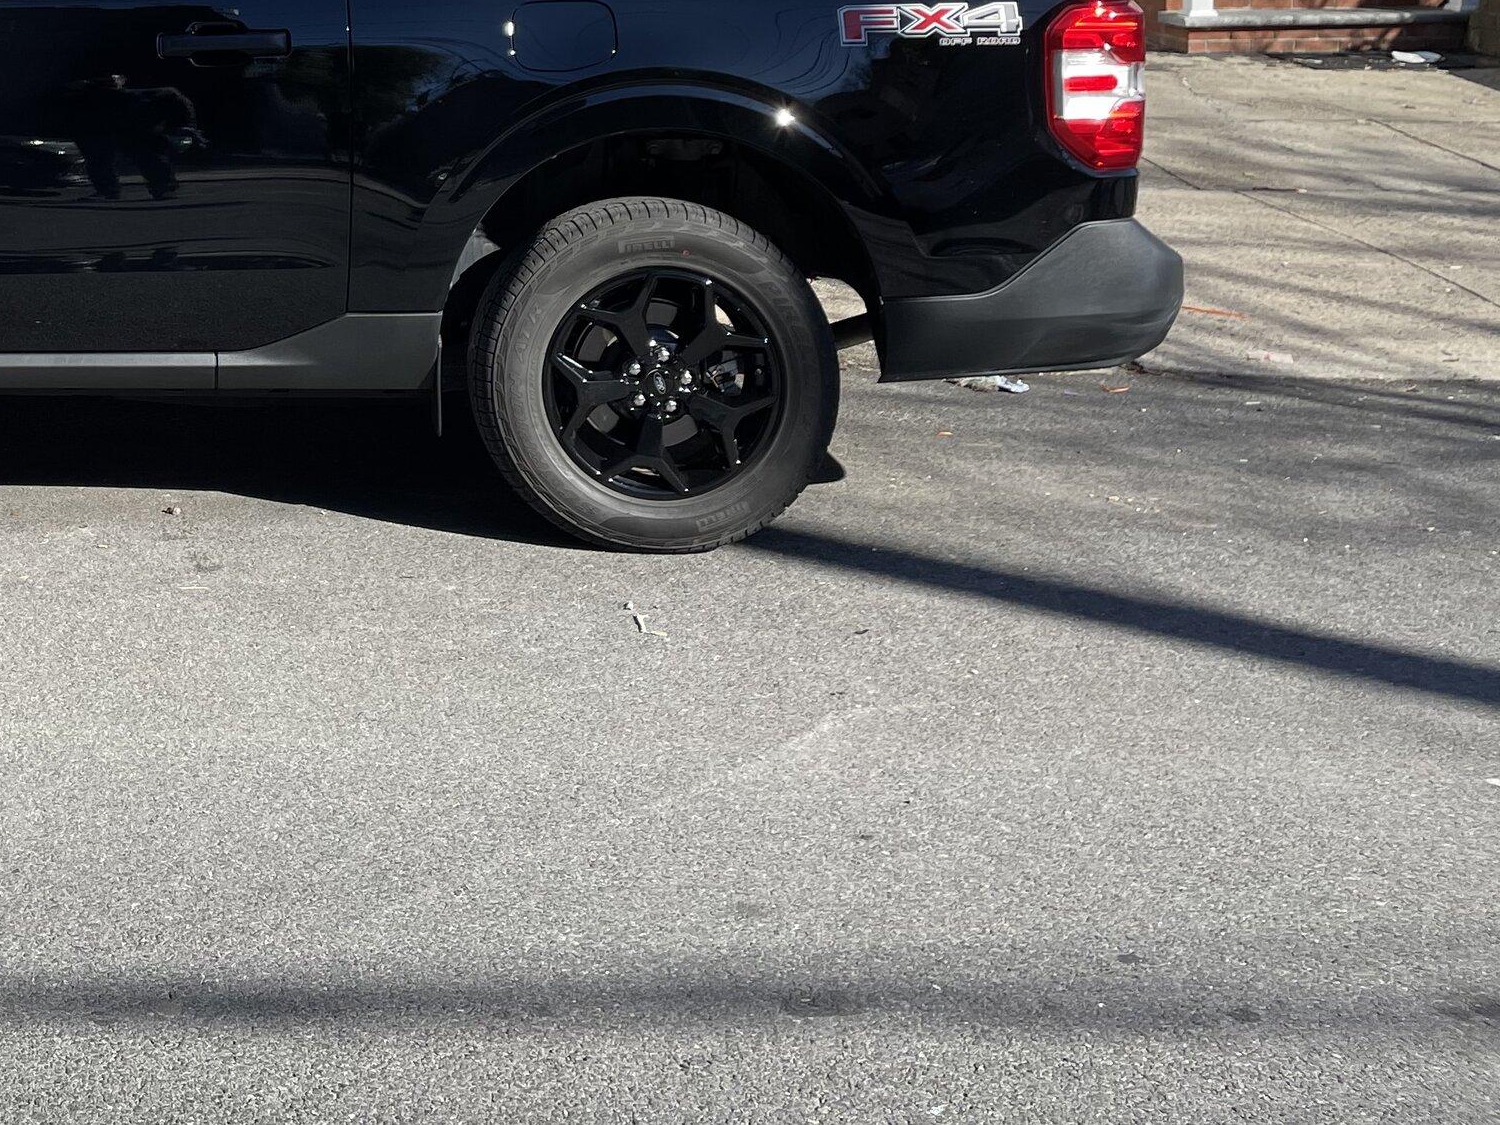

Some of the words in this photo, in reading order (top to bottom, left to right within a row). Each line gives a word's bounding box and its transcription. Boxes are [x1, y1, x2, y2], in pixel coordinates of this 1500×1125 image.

[837, 2, 1024, 47] FX4
[939, 36, 973, 47] OFF
[976, 36, 1021, 46] ROAD
